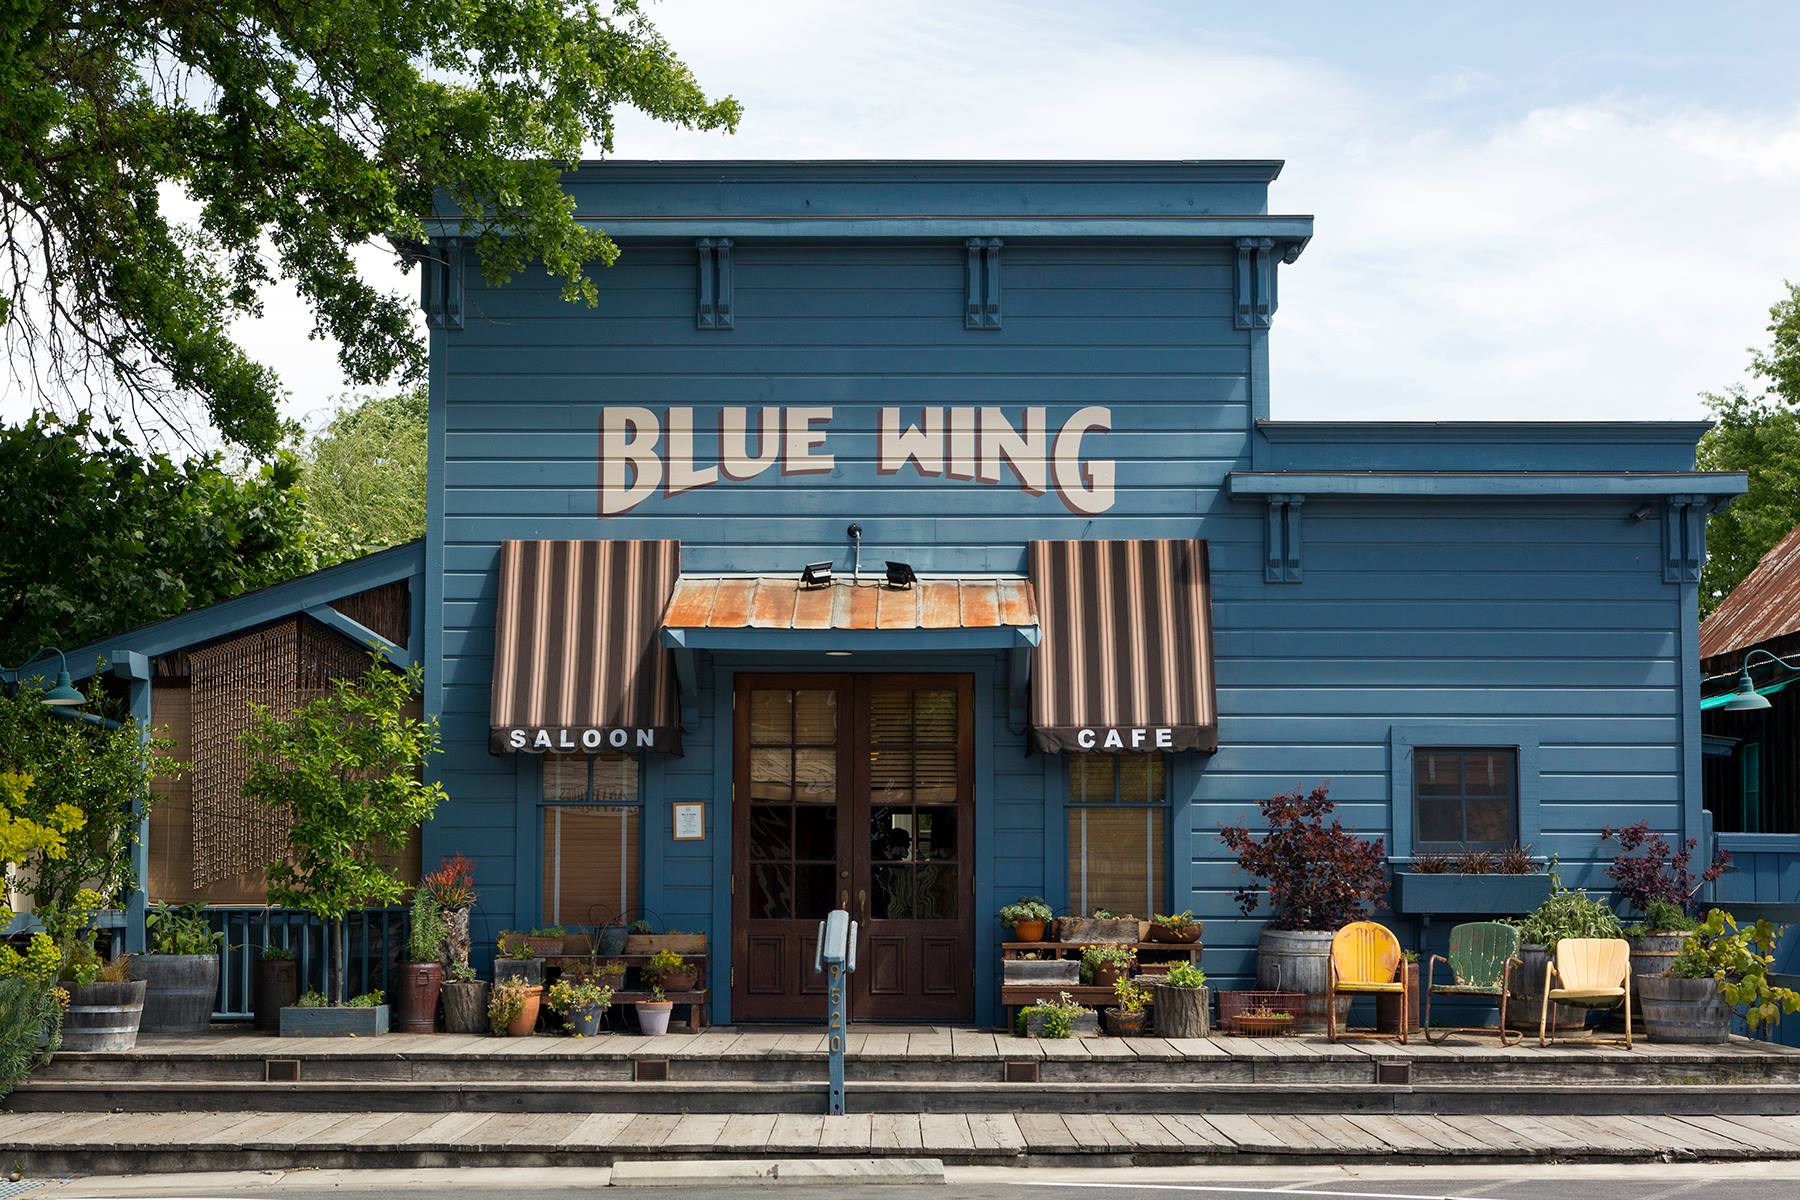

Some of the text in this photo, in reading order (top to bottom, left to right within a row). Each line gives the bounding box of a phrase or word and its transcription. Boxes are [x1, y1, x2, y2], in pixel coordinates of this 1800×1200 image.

[598, 406, 1115, 518] BLUE WING
[510, 729, 654, 748] SALOON
[1077, 728, 1173, 748] CAFE
[831, 965, 841, 1053] 9520
